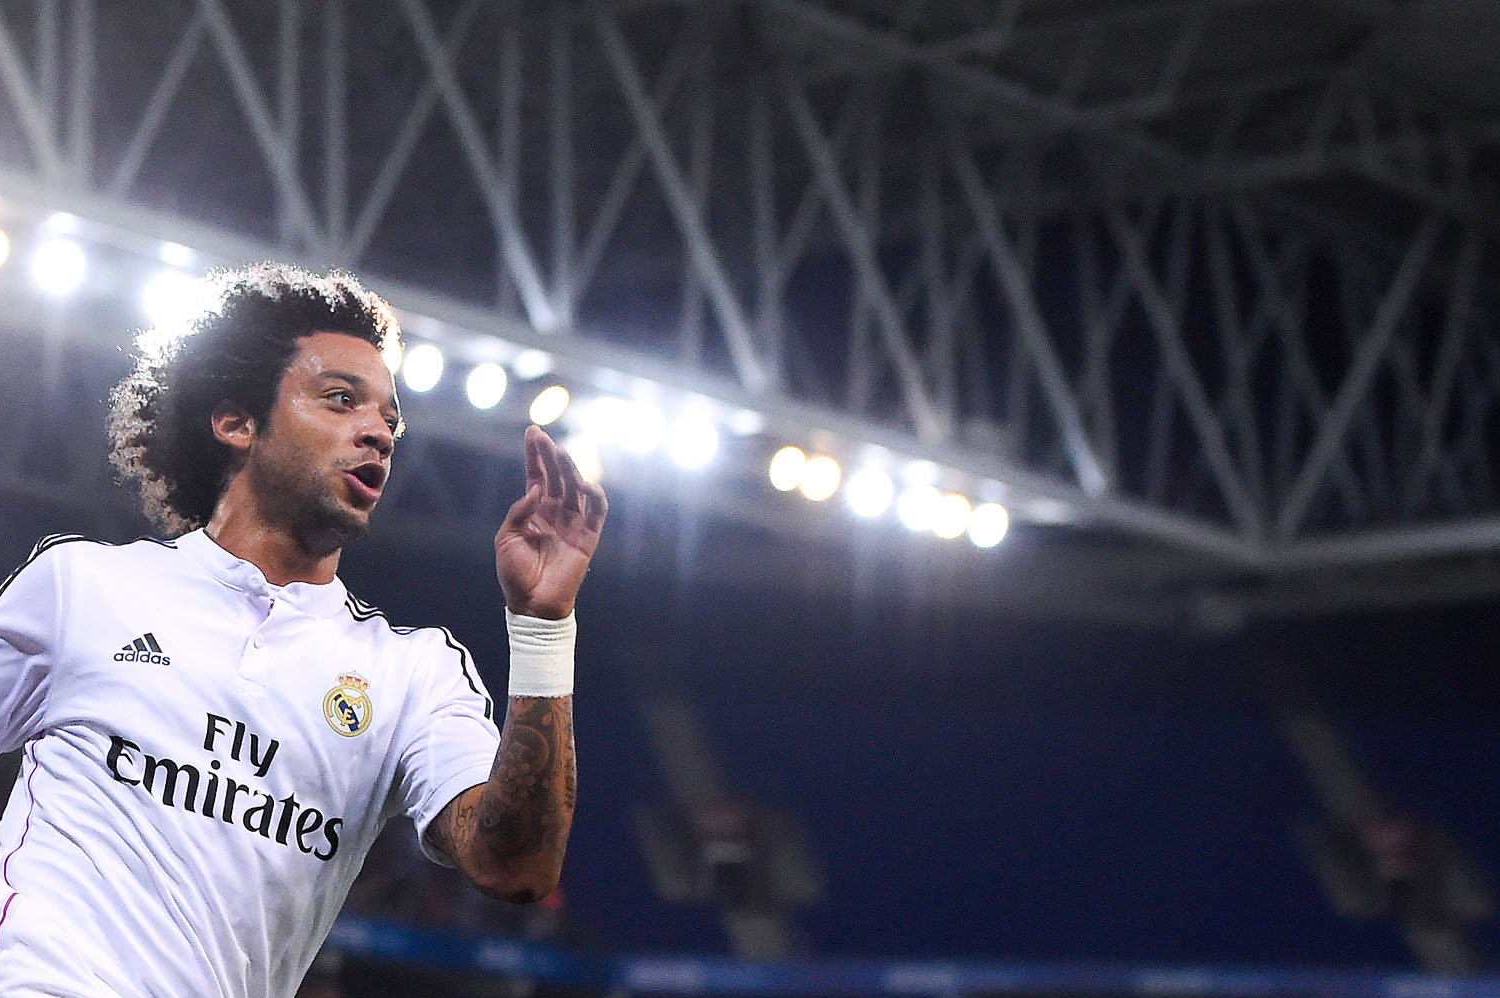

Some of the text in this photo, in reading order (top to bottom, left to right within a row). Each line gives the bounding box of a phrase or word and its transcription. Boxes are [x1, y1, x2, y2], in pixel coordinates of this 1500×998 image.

[113, 650, 171, 666] adidas
[203, 712, 279, 777] Fly
[106, 735, 344, 861] Emirates
